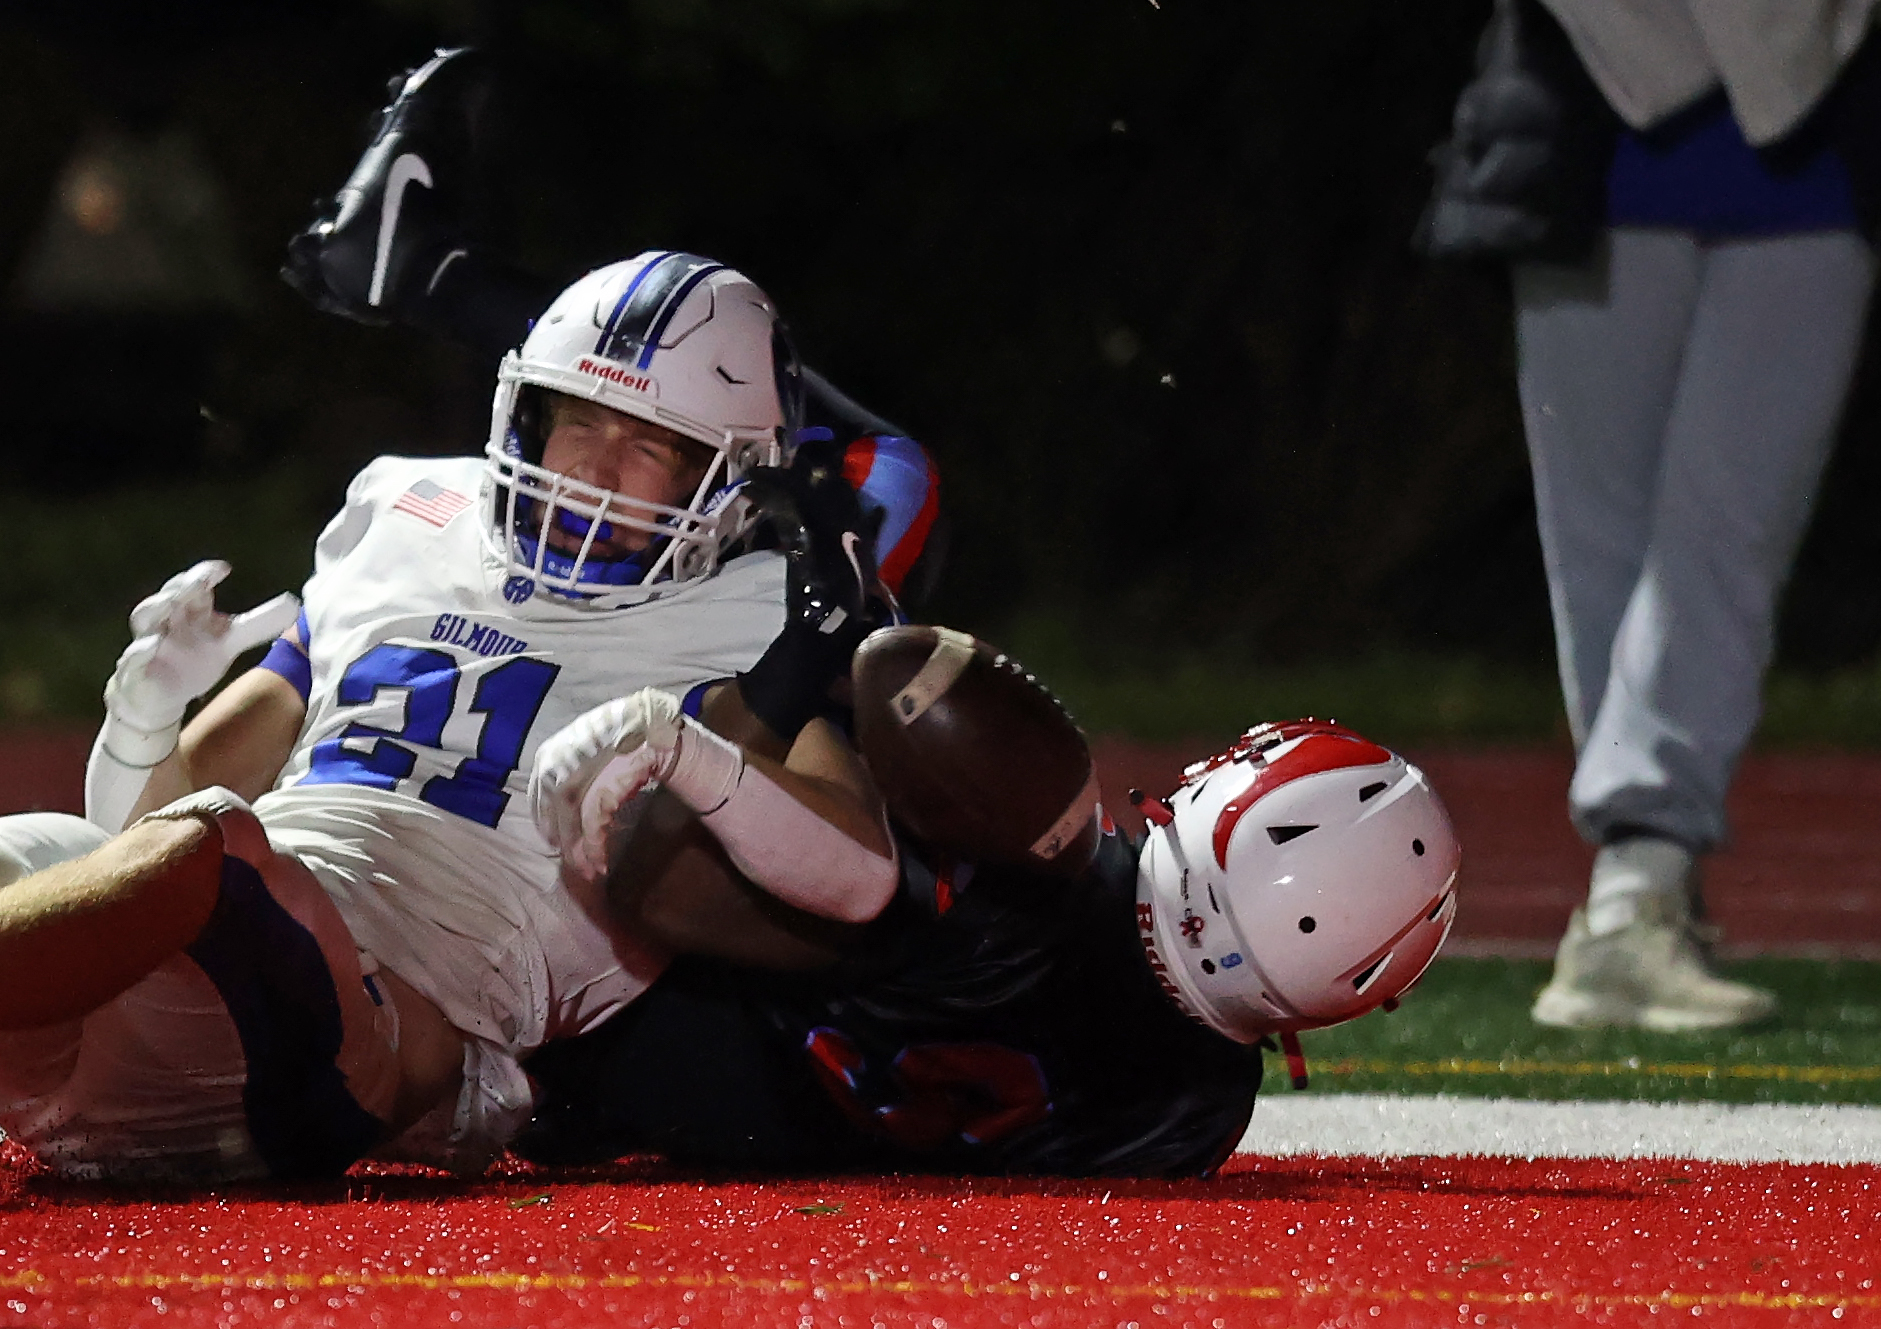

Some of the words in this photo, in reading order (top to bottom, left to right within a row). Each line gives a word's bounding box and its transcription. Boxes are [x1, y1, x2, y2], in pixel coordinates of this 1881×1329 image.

[578, 358, 650, 392] Riddell
[430, 612, 528, 657] GILMOUR
[295, 643, 562, 829] 21
[1136, 902, 1206, 1026] Riddel
